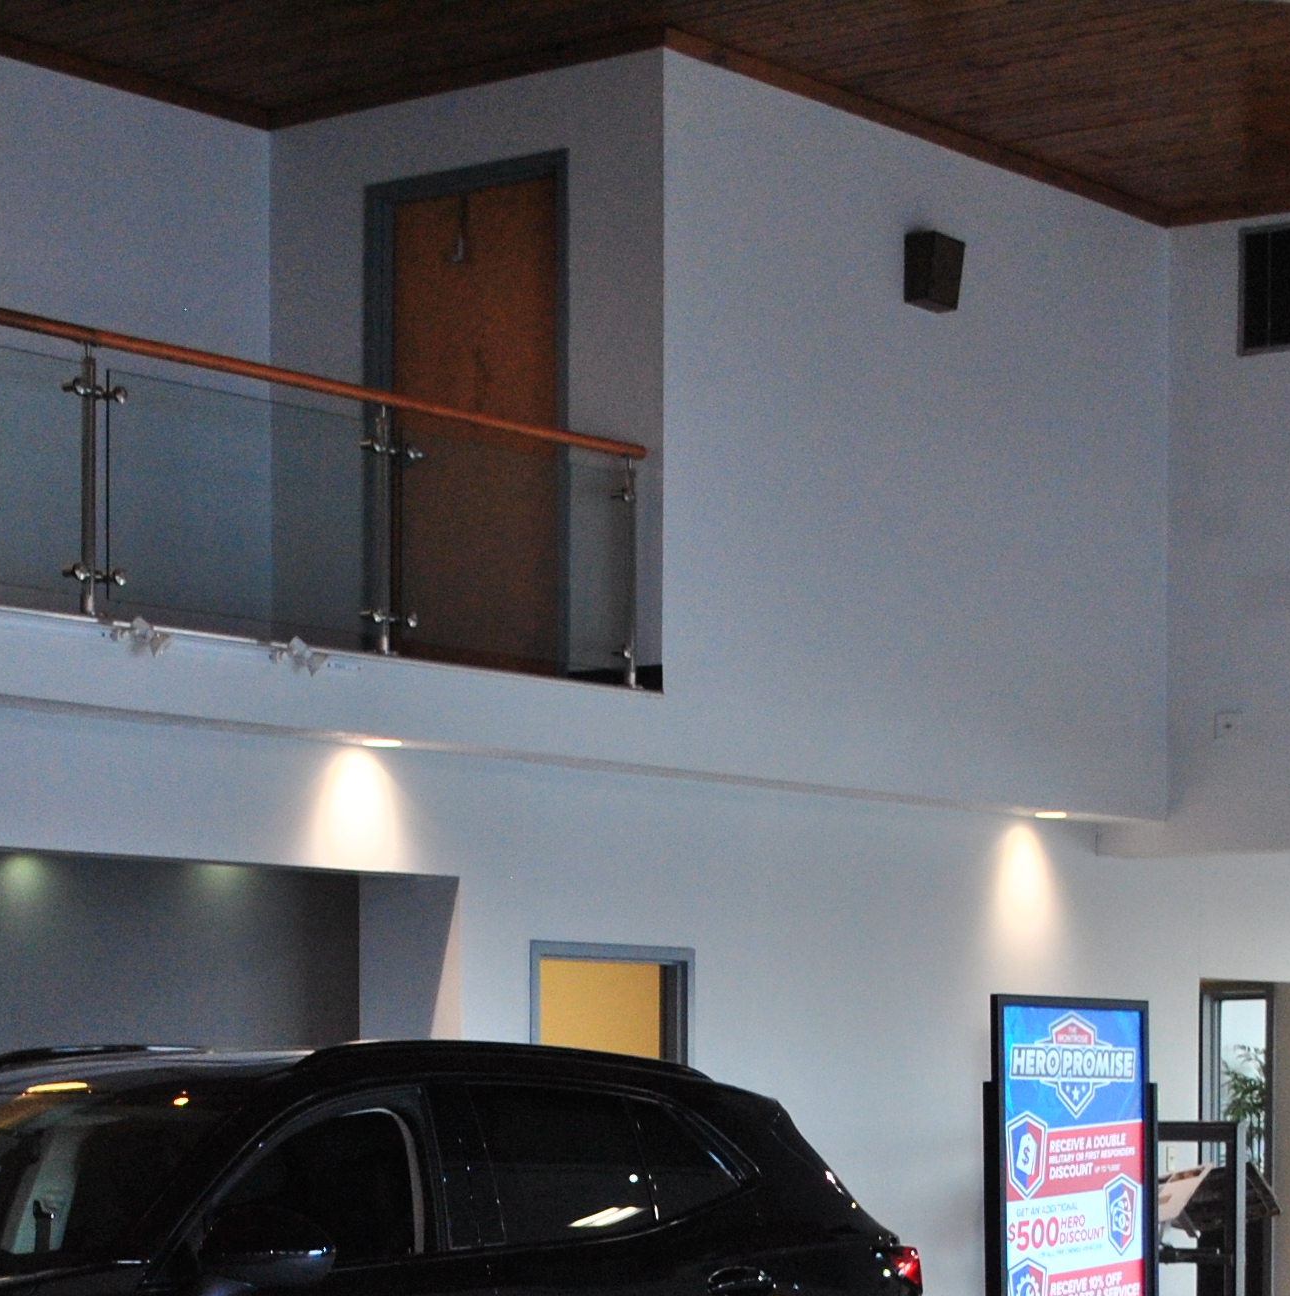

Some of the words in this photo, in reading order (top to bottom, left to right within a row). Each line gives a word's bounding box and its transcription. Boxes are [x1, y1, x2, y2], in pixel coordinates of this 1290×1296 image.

[1012, 1048, 1059, 1076] HERO
[1061, 1050, 1134, 1079] PROMISE
[1049, 1136, 1085, 1153] RECEIVE
[1093, 1133, 1126, 1148] DOUBLE
[1049, 1162, 1093, 1180] DISCOUNT
[1007, 1216, 1059, 1251] $500
[1061, 1214, 1085, 1229] HERO
[1060, 1226, 1105, 1245] DISCOUNT
[1050, 1277, 1087, 1296] RECEIVE
[1105, 1271, 1122, 1287] OFF
